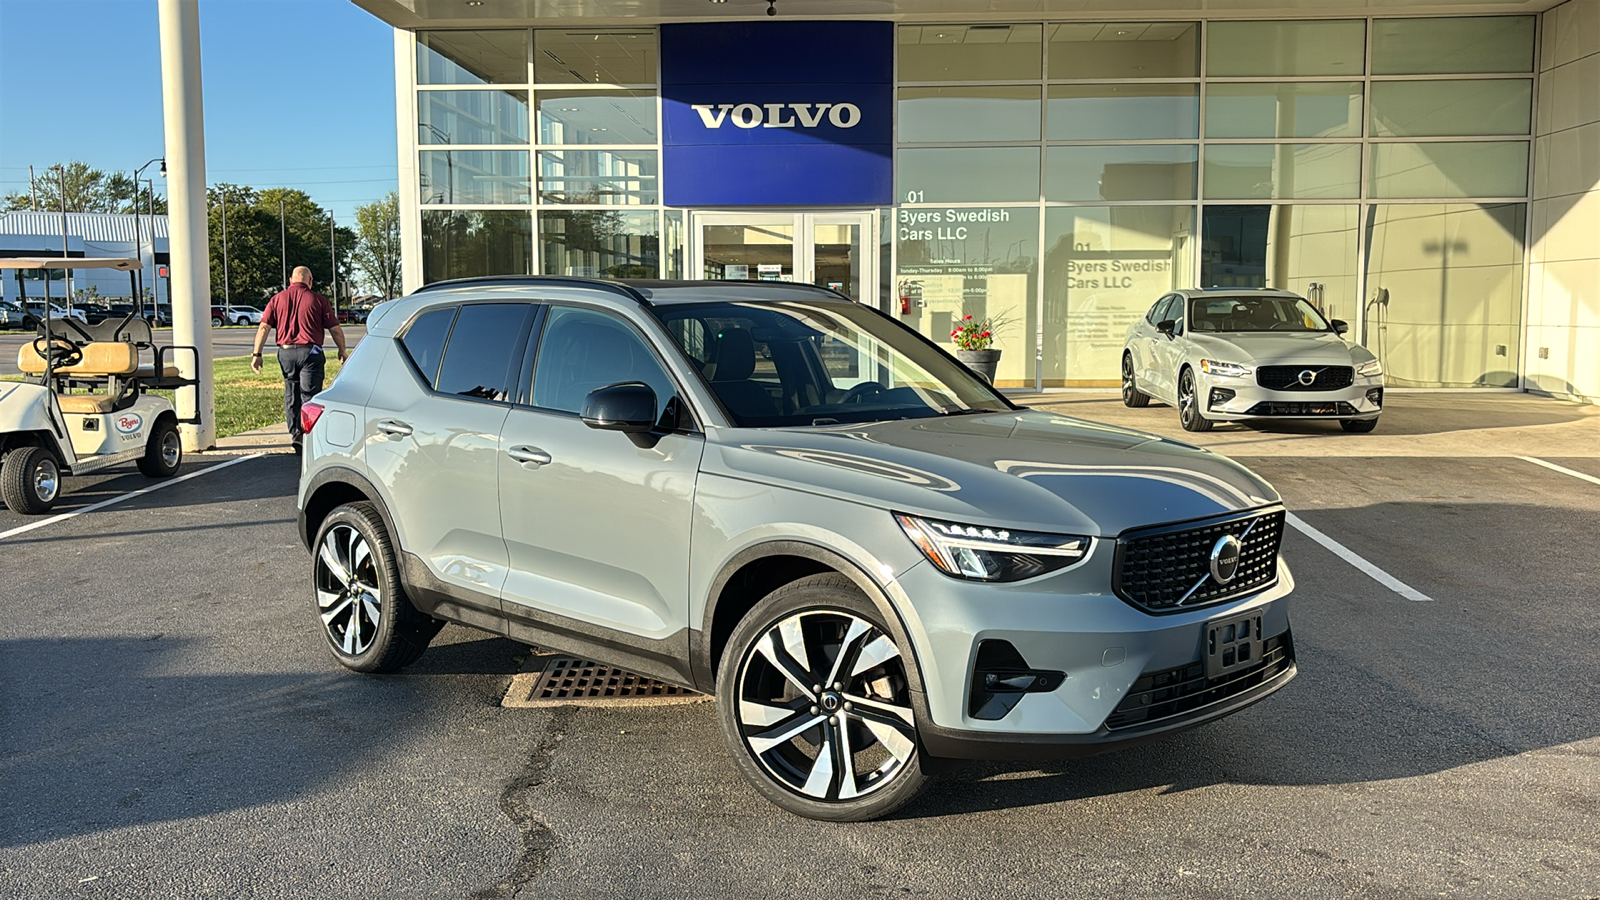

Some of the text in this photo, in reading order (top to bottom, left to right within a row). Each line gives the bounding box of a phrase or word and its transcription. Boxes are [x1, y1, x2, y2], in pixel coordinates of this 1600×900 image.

[691, 103, 861, 128] VOLVO
[904, 190, 924, 203] 01
[900, 209, 1010, 226] Byers Swedish
[900, 227, 968, 241] Cars LLC
[1067, 259, 1171, 275] Byers Swedish
[1067, 276, 1132, 289] Cars LLC
[1219, 556, 1237, 565] VOLVO
